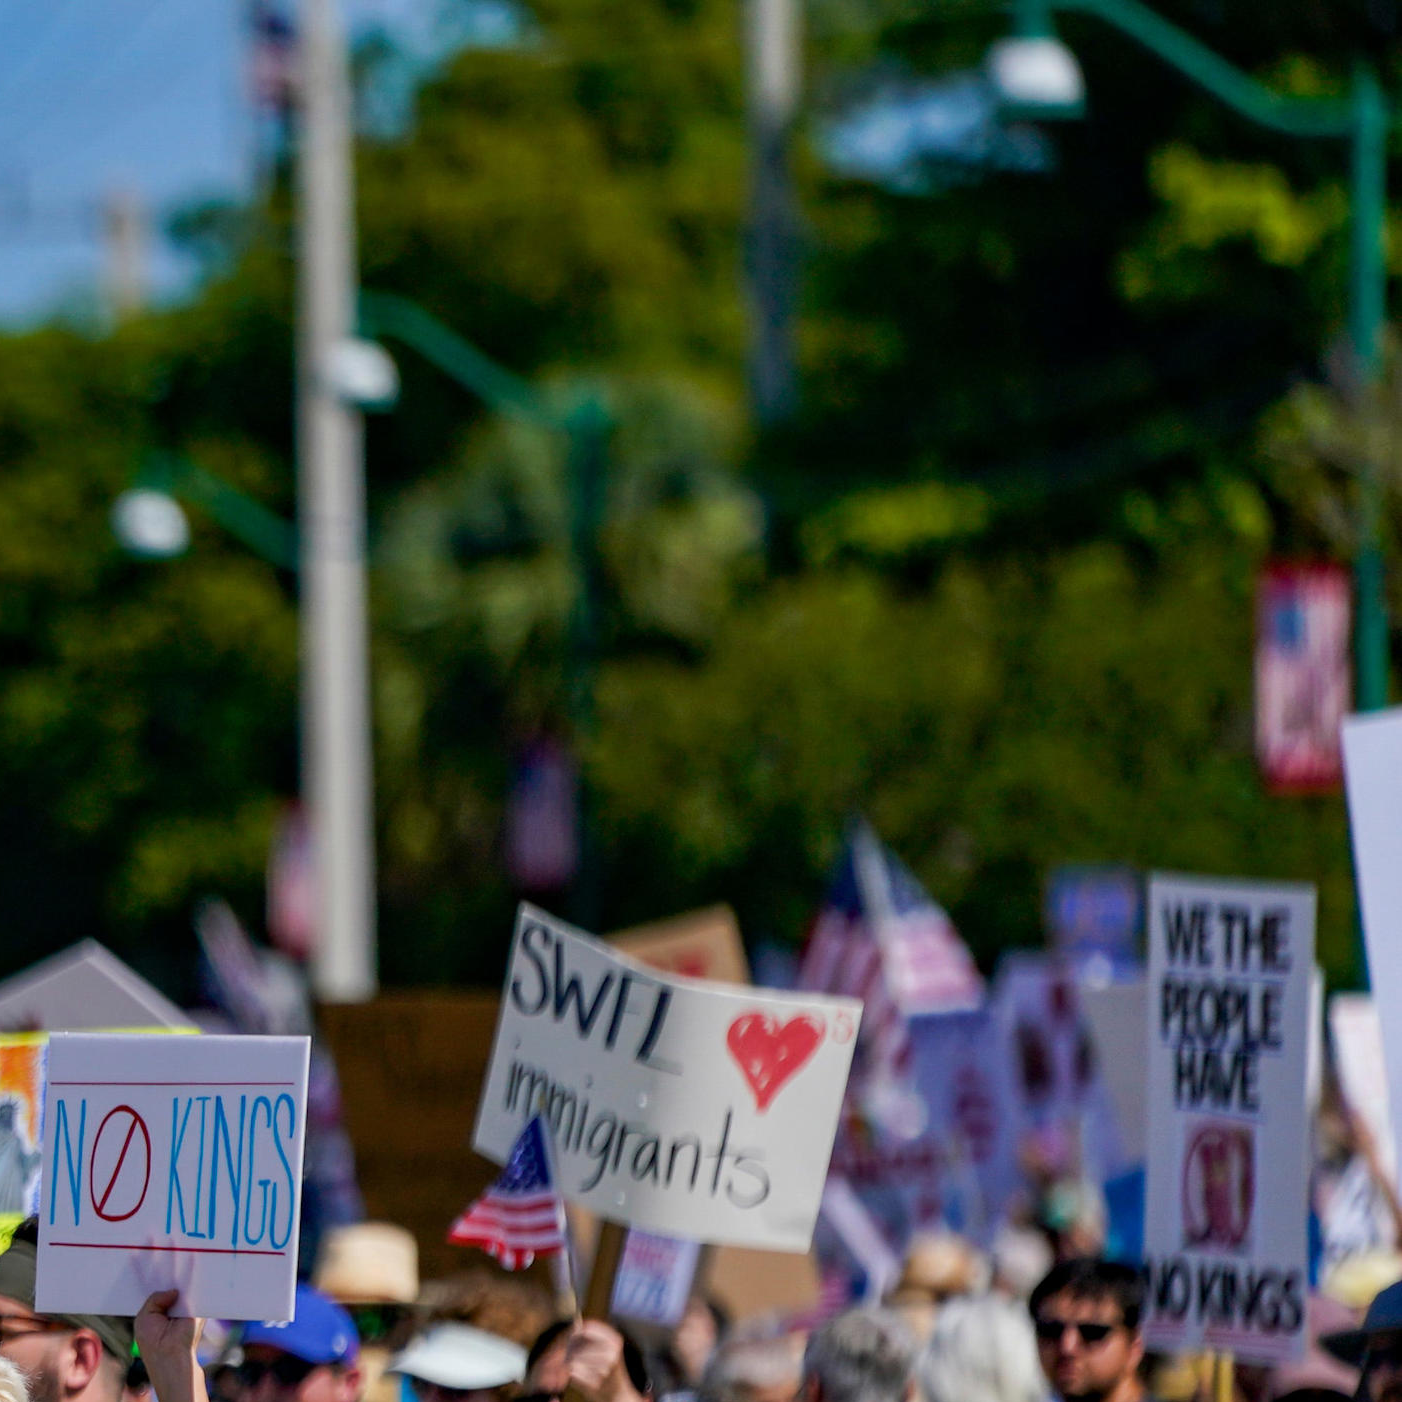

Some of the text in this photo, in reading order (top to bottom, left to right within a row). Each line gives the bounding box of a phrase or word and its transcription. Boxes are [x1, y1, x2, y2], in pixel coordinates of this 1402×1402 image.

[1163, 904, 1290, 972] WE THE
[511, 922, 683, 1077] SWFL
[1159, 977, 1285, 1052] PEOPLE
[1174, 1053, 1260, 1112] HAVE
[503, 1034, 771, 1209] immigrants
[166, 1092, 296, 1250] KINGS
[1144, 1257, 1304, 1333] NO KINGS
